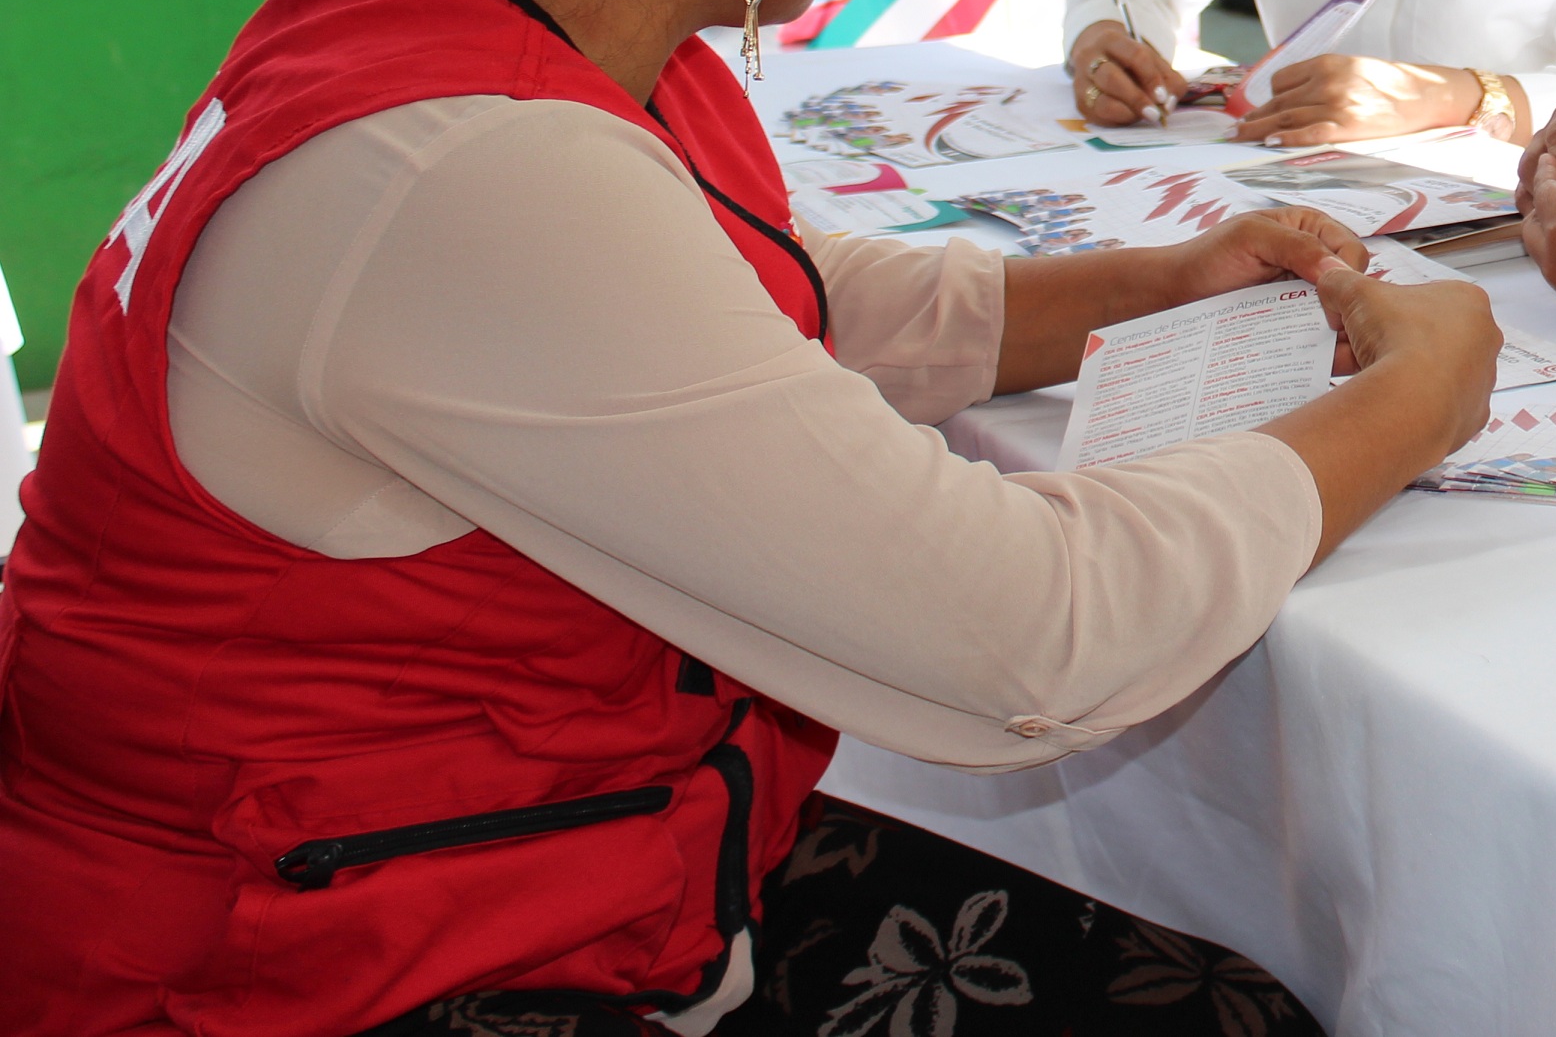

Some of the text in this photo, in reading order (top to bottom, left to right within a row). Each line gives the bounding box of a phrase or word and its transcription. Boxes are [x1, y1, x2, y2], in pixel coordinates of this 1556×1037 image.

[1109, 329, 1152, 347] Centros
[1154, 324, 1169, 335] de
[1171, 305, 1234, 330] Enseñanza
[1235, 295, 1277, 312] Abierta
